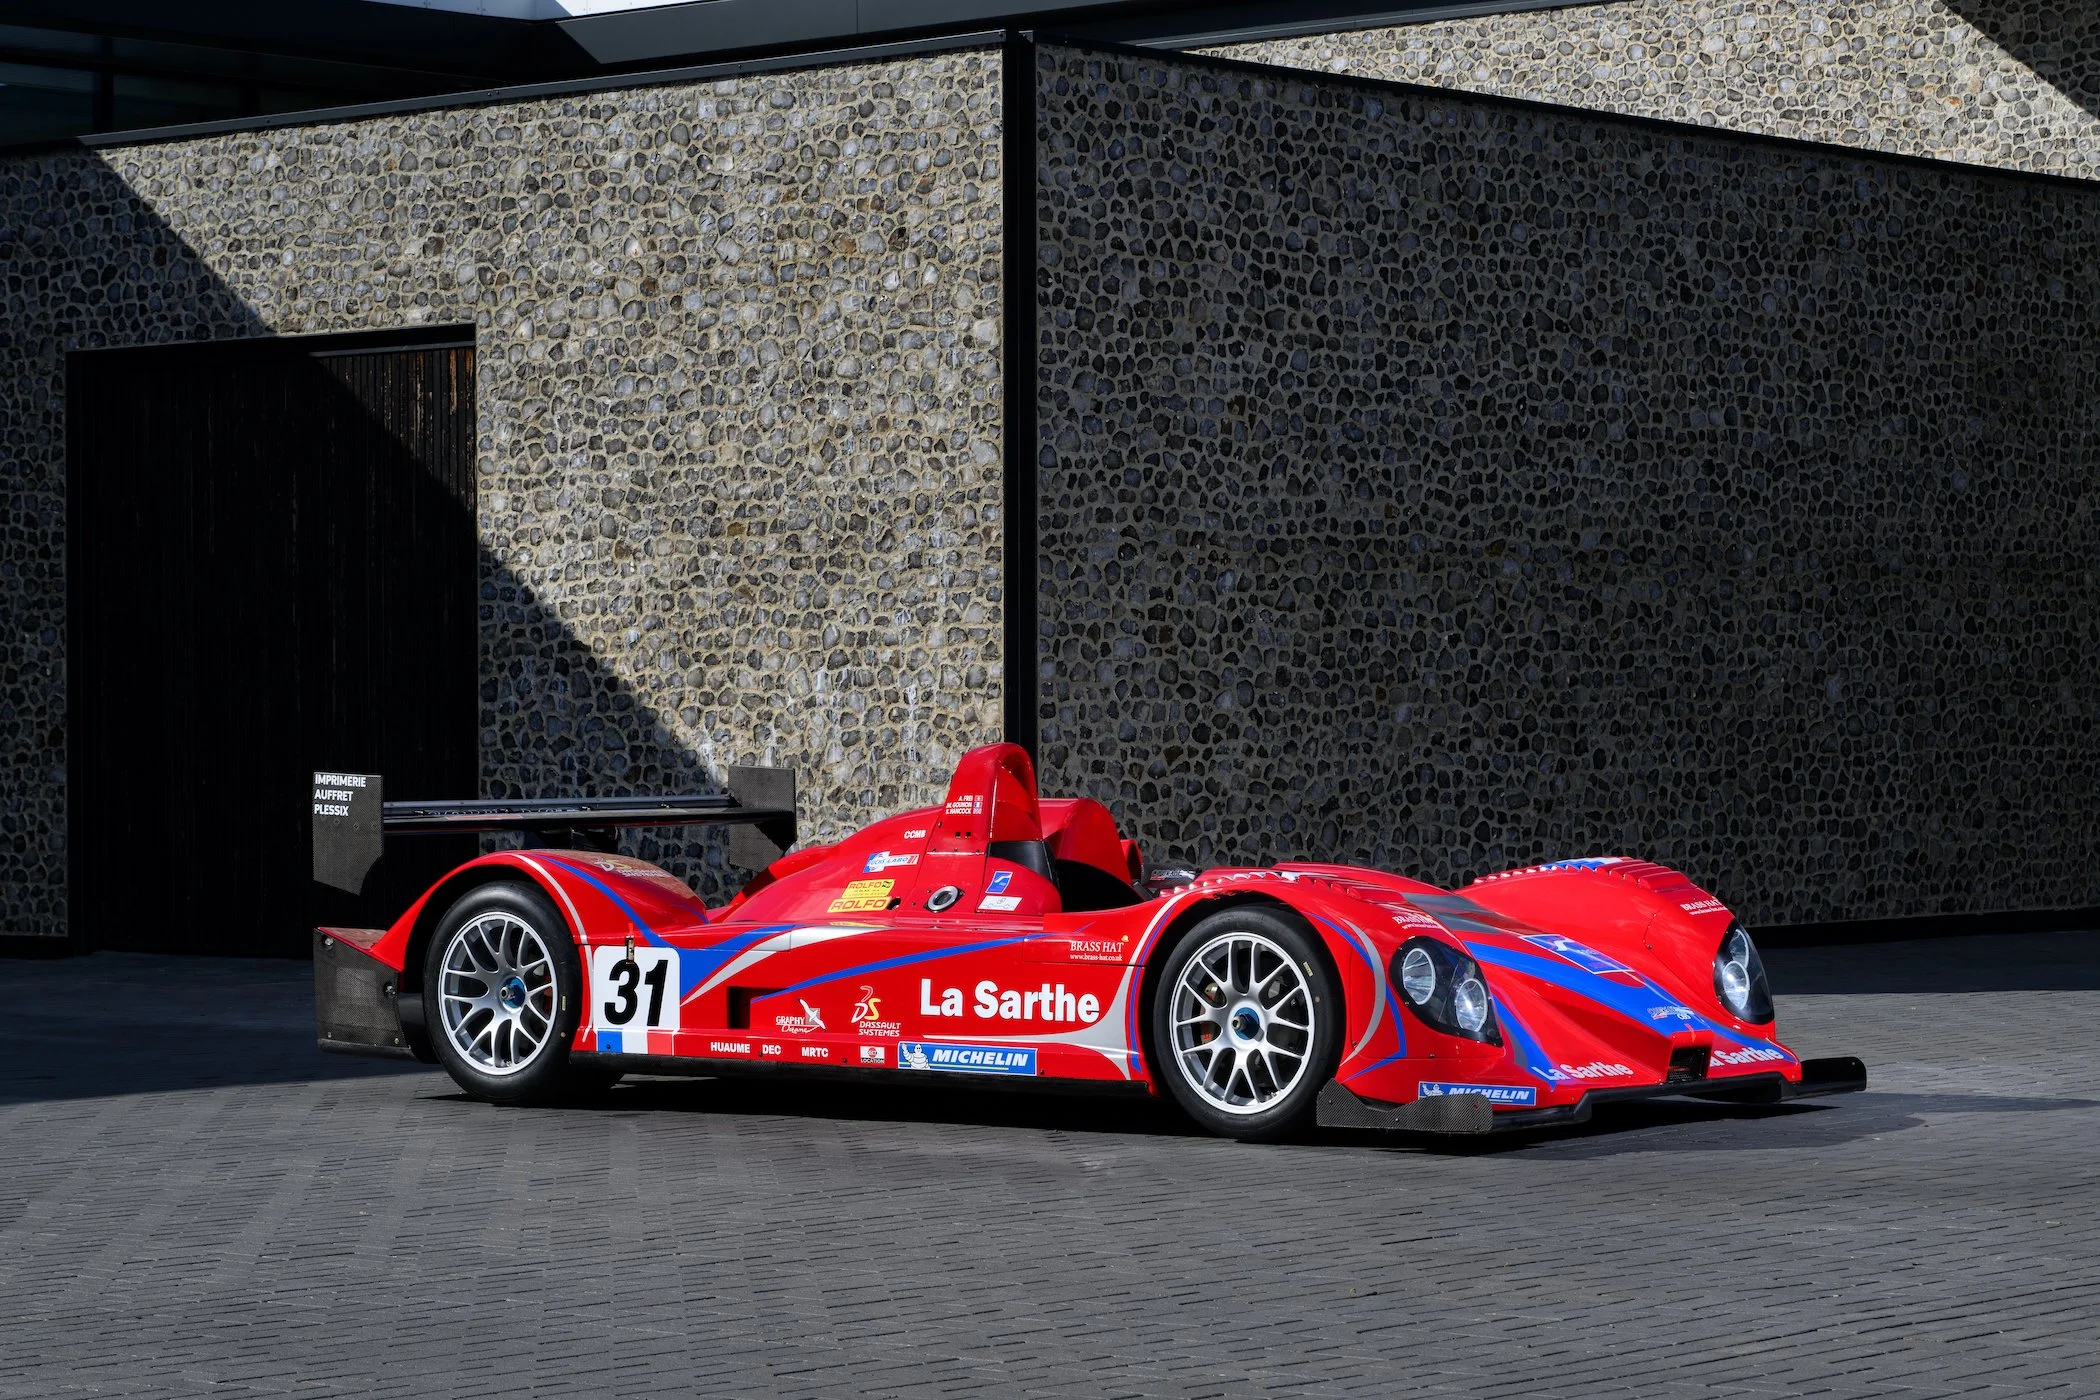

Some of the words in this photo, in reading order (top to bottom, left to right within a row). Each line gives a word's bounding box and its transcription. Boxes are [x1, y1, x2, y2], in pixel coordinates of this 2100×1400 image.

[315, 774, 366, 787] IMPRIMERIE
[314, 789, 353, 801] AUFFRET
[314, 804, 349, 816] PLESSIX
[831, 899, 886, 910] ROLFO
[1070, 941, 1101, 951] BRASS
[1102, 942, 1124, 952] HAT
[604, 959, 668, 1027] 31
[920, 978, 963, 1017] La
[974, 980, 1099, 1023] Sarthe
[775, 1015, 805, 1025] GRAPHY
[859, 1021, 901, 1030] DASSAULT
[858, 1029, 900, 1037] SYSTEMES
[710, 1041, 750, 1054] HUAUME
[762, 1044, 781, 1055] DEC
[801, 1047, 829, 1058] MRTC
[932, 1049, 1029, 1067] MICHELIN
[1714, 1047, 1784, 1065] Sarthe
[1531, 1066, 1571, 1080] La
[1560, 1062, 1634, 1079] Sarthe
